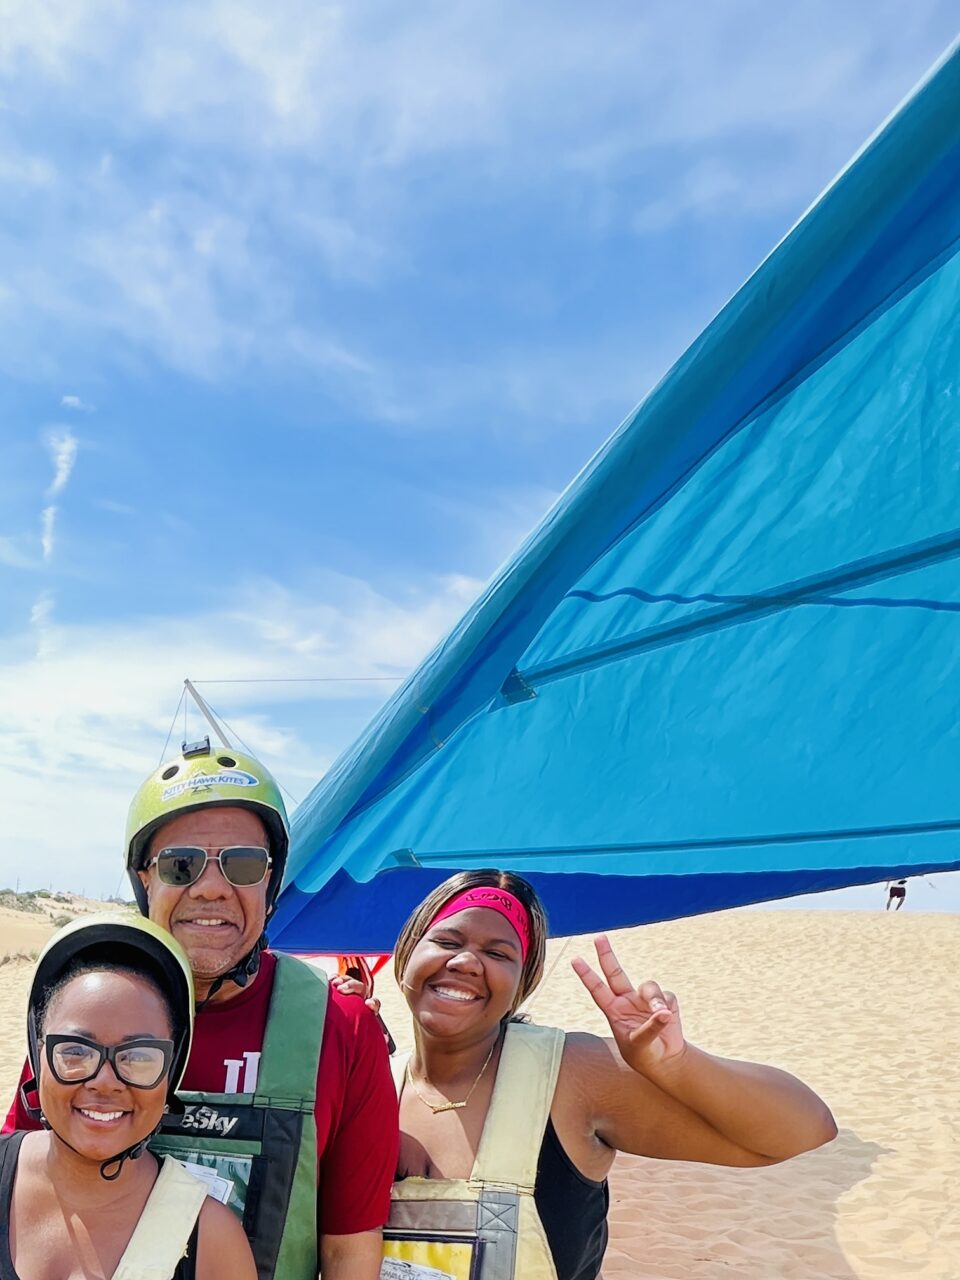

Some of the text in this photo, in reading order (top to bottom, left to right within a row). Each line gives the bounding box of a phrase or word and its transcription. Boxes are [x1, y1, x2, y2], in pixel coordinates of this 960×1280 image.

[163, 775, 244, 797] KITTY HAWK KITES
[181, 1105, 239, 1137] eSky
